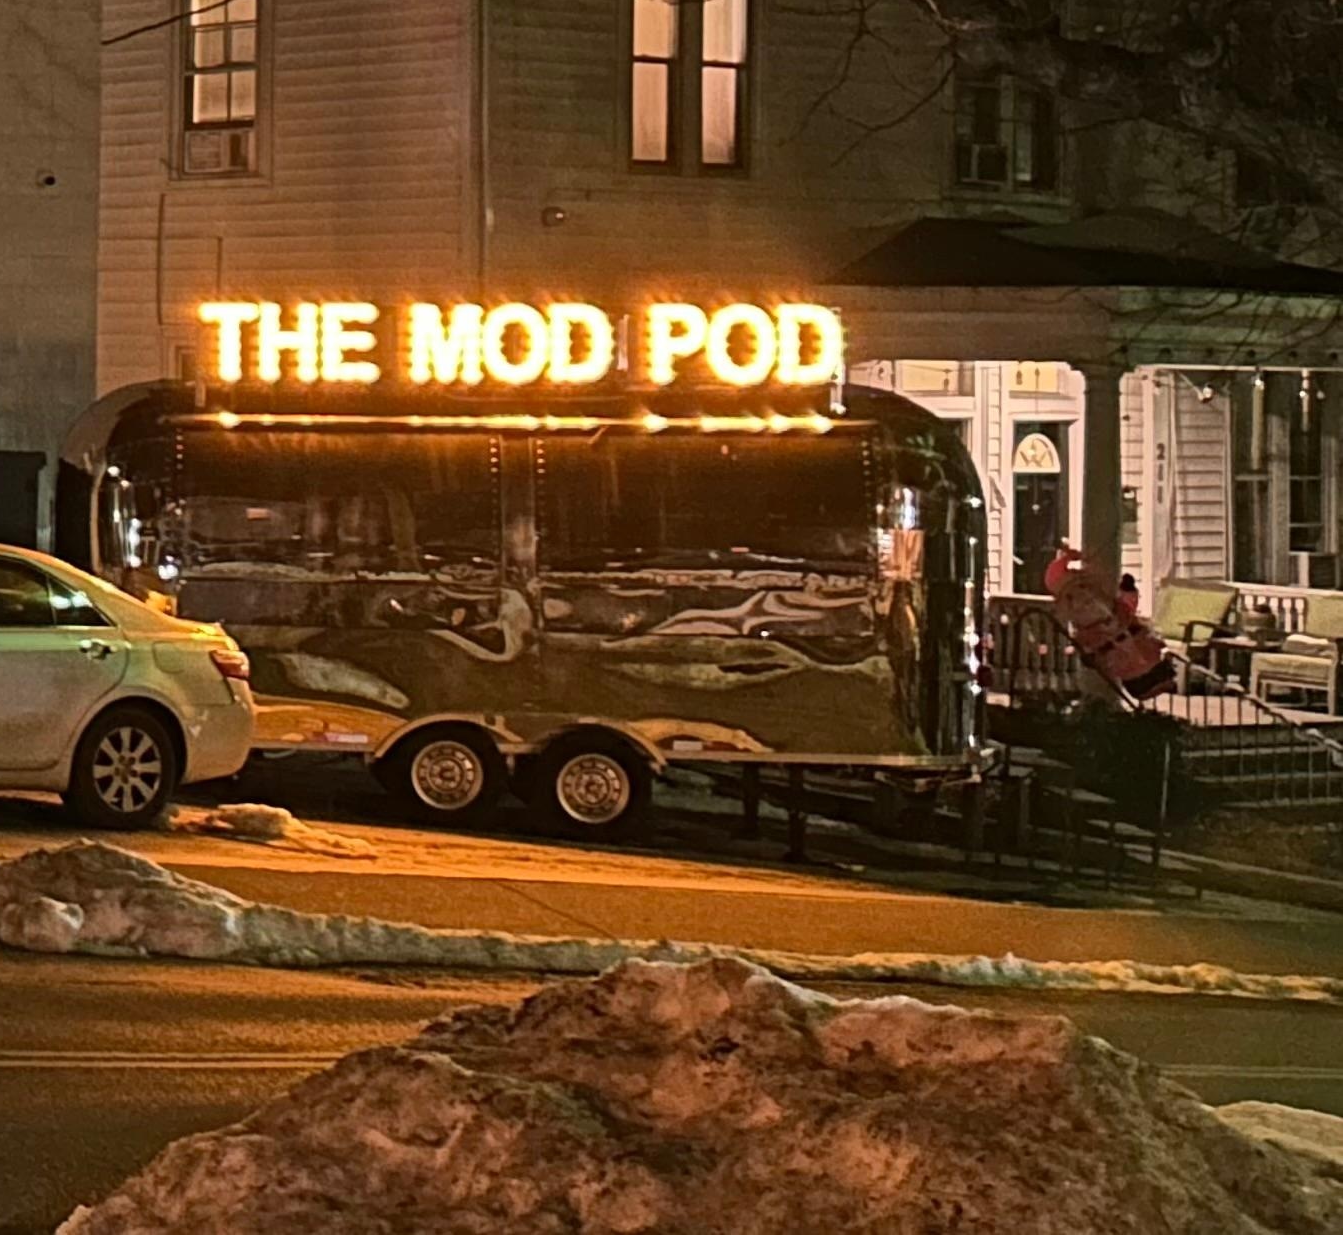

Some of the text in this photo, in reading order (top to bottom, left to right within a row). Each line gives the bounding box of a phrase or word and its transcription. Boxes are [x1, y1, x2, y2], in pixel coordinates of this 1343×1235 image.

[197, 301, 840, 385] THE MOD POD
